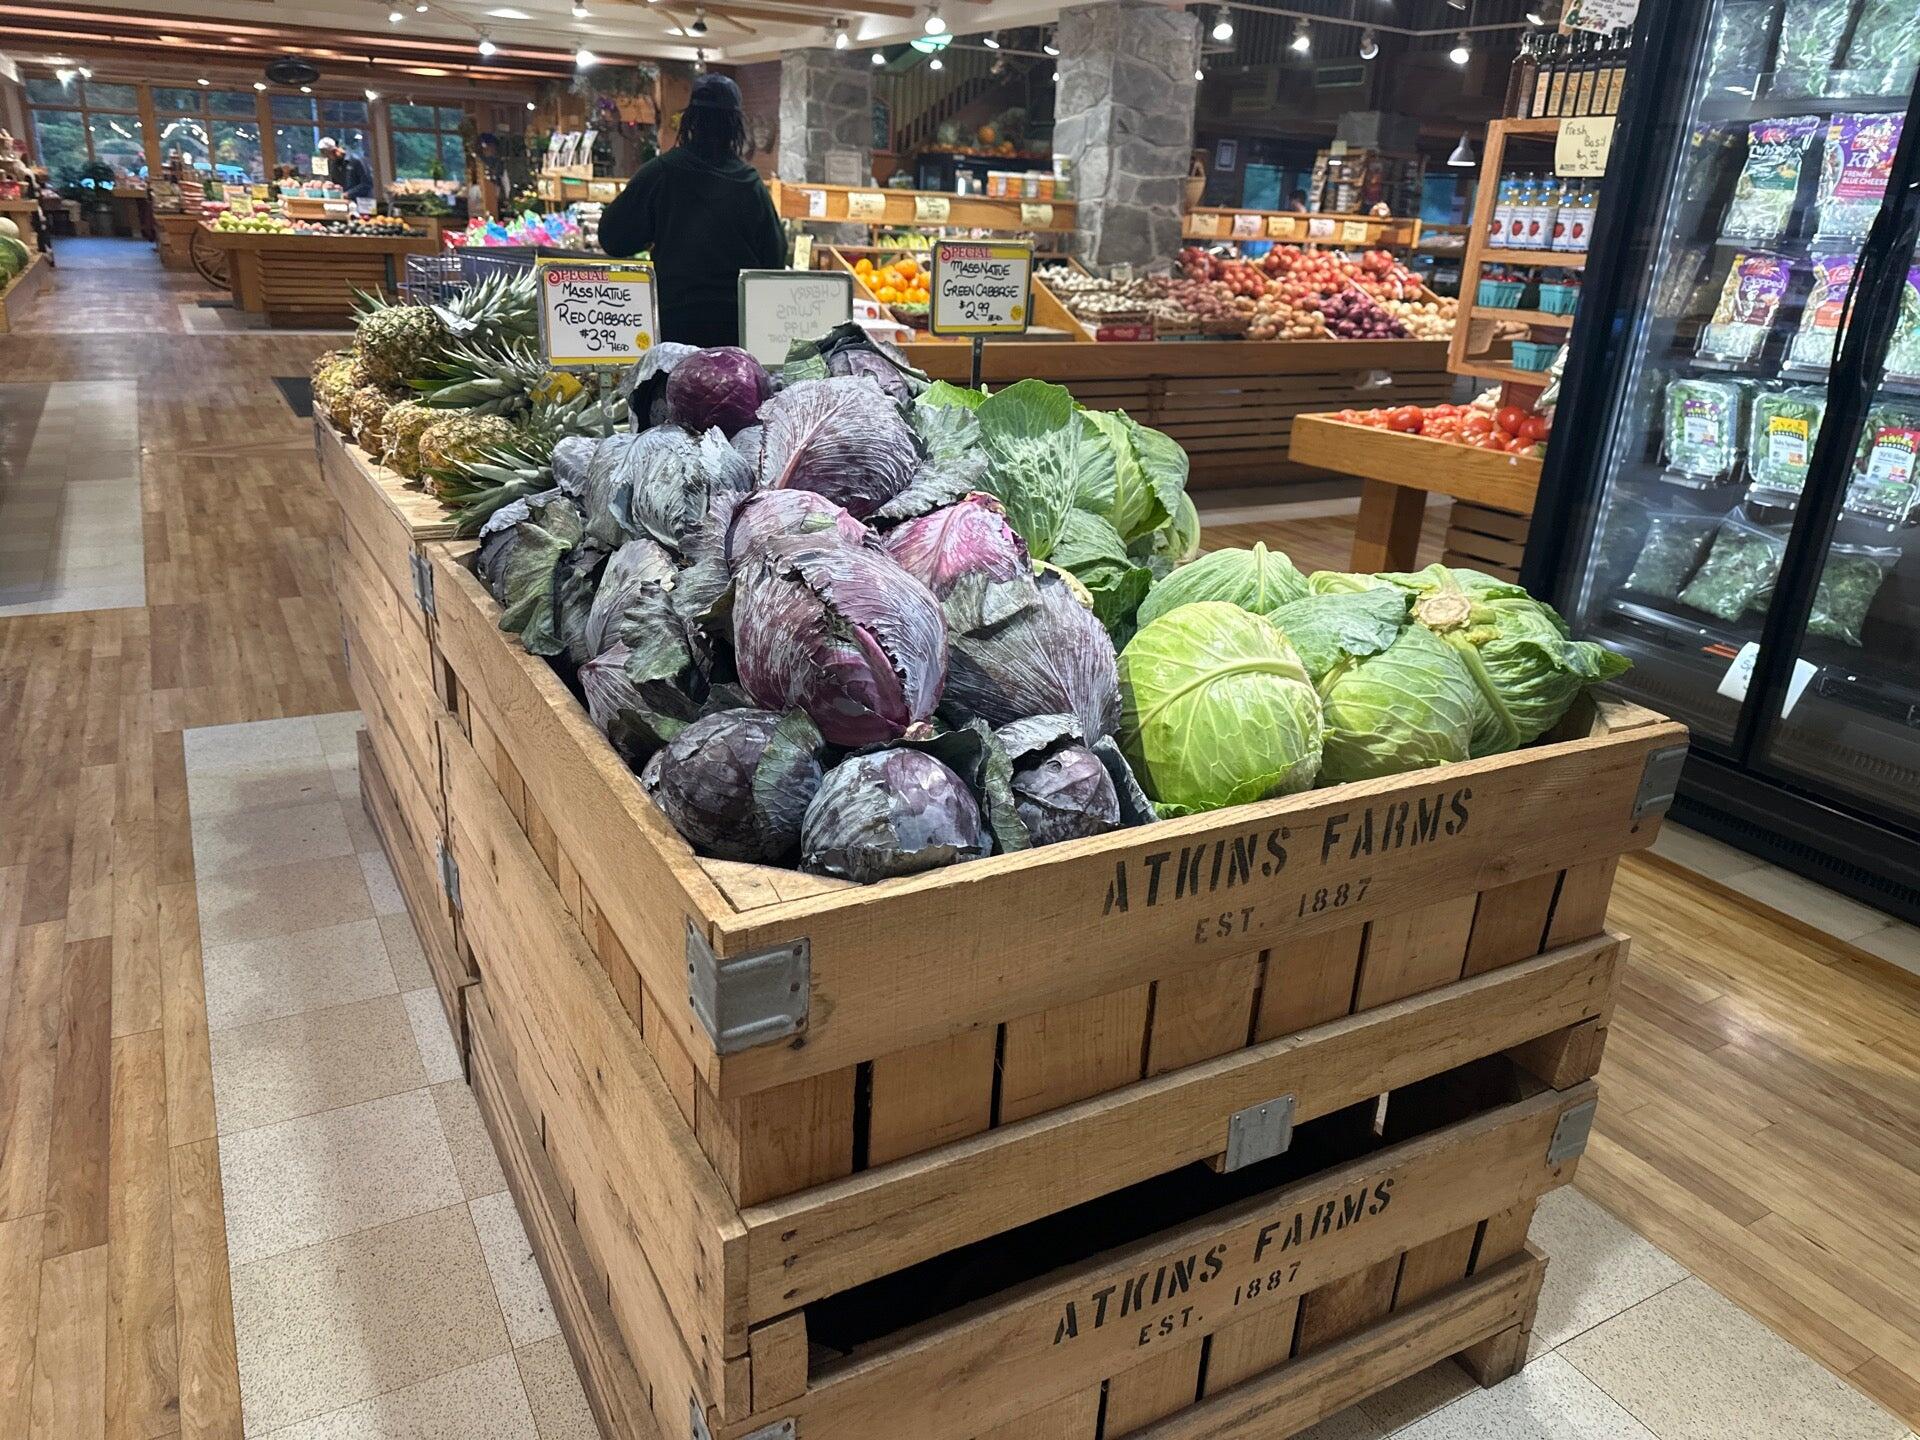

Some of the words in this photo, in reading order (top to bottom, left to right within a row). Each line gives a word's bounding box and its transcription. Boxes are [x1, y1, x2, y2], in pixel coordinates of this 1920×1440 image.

[940, 244, 993, 261] SPECIAL
[548, 269, 609, 285] SPECIAL
[950, 260, 980, 275] MASS
[980, 262, 1011, 276] NATIVE
[562, 282, 594, 298] MASS
[594, 284, 632, 301] NATIVE
[943, 279, 975, 297] GREEN
[975, 283, 1020, 298] CABBAGE
[554, 303, 587, 325] RED
[587, 309, 643, 327] CABBAGE
[1104, 828, 1291, 915] ATKINS
[1321, 787, 1473, 866] FARMS
[1194, 906, 1265, 944] EST.
[1299, 876, 1372, 917] 1887
[1053, 1243, 1227, 1346] ATKINS
[1254, 1177, 1395, 1264] FARMS
[1138, 1305, 1204, 1347] EST.
[1233, 1260, 1301, 1306] 1887
